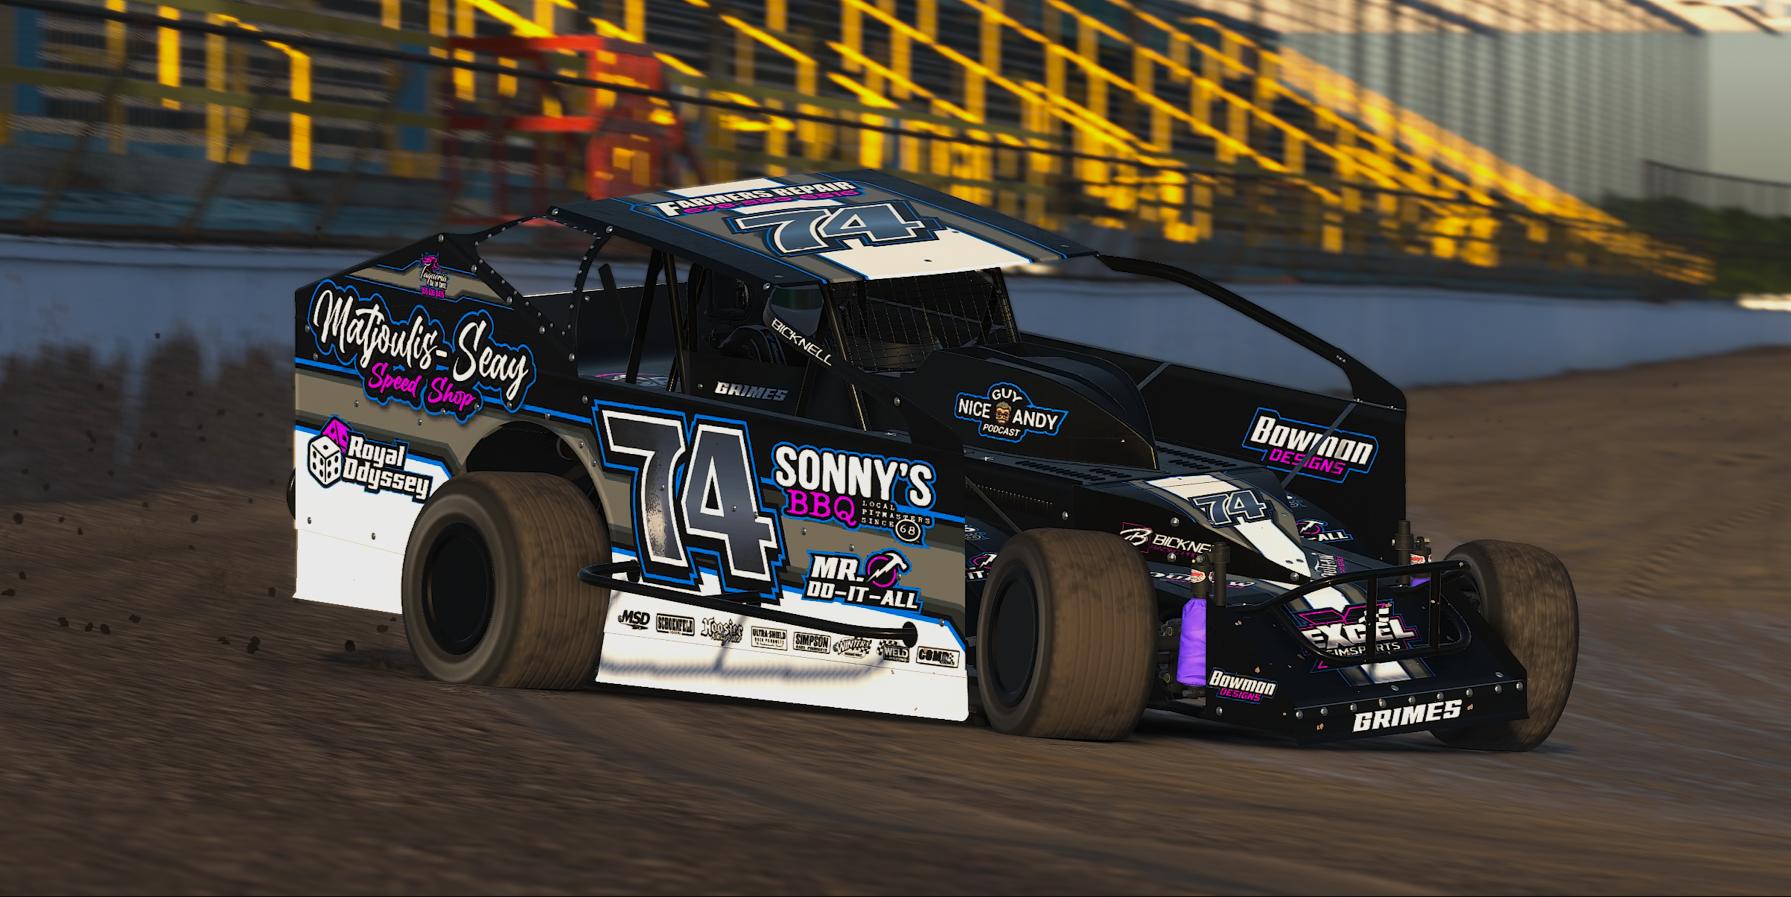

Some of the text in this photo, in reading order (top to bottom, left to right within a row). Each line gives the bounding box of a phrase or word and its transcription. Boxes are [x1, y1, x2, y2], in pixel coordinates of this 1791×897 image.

[654, 189, 769, 217] FARMERS
[770, 181, 857, 197] REPAIR
[734, 202, 926, 254] 74
[771, 317, 833, 367] BICKNELL
[368, 362, 477, 411] Speed Shop
[714, 381, 790, 402] GRIMES
[992, 388, 1023, 403] GUY
[958, 398, 1059, 430] NICE ANDY
[982, 423, 1021, 437] PODCAST
[348, 435, 406, 468] Royal
[342, 457, 431, 501] Odyssey
[775, 445, 933, 507] SONNY'S
[602, 410, 778, 582] 74
[787, 489, 857, 526] BBQ
[862, 500, 896, 511] LOCAL
[1193, 489, 1268, 525] 74
[861, 509, 931, 525] PITMASTERS
[861, 517, 916, 536] SINCE 68
[1152, 534, 1214, 554] BICKNE
[811, 555, 865, 583] MR.
[806, 580, 919, 609] DO-IT-ALL
[620, 609, 651, 626] MSD
[795, 632, 829, 648] SIMPSON
[1300, 618, 1416, 650] EXCEL
[883, 646, 909, 658] WELD
[1326, 642, 1401, 657] IMSPRTS
[1219, 687, 1261, 702] DESIGNS
[1352, 699, 1463, 733] GRIMES
